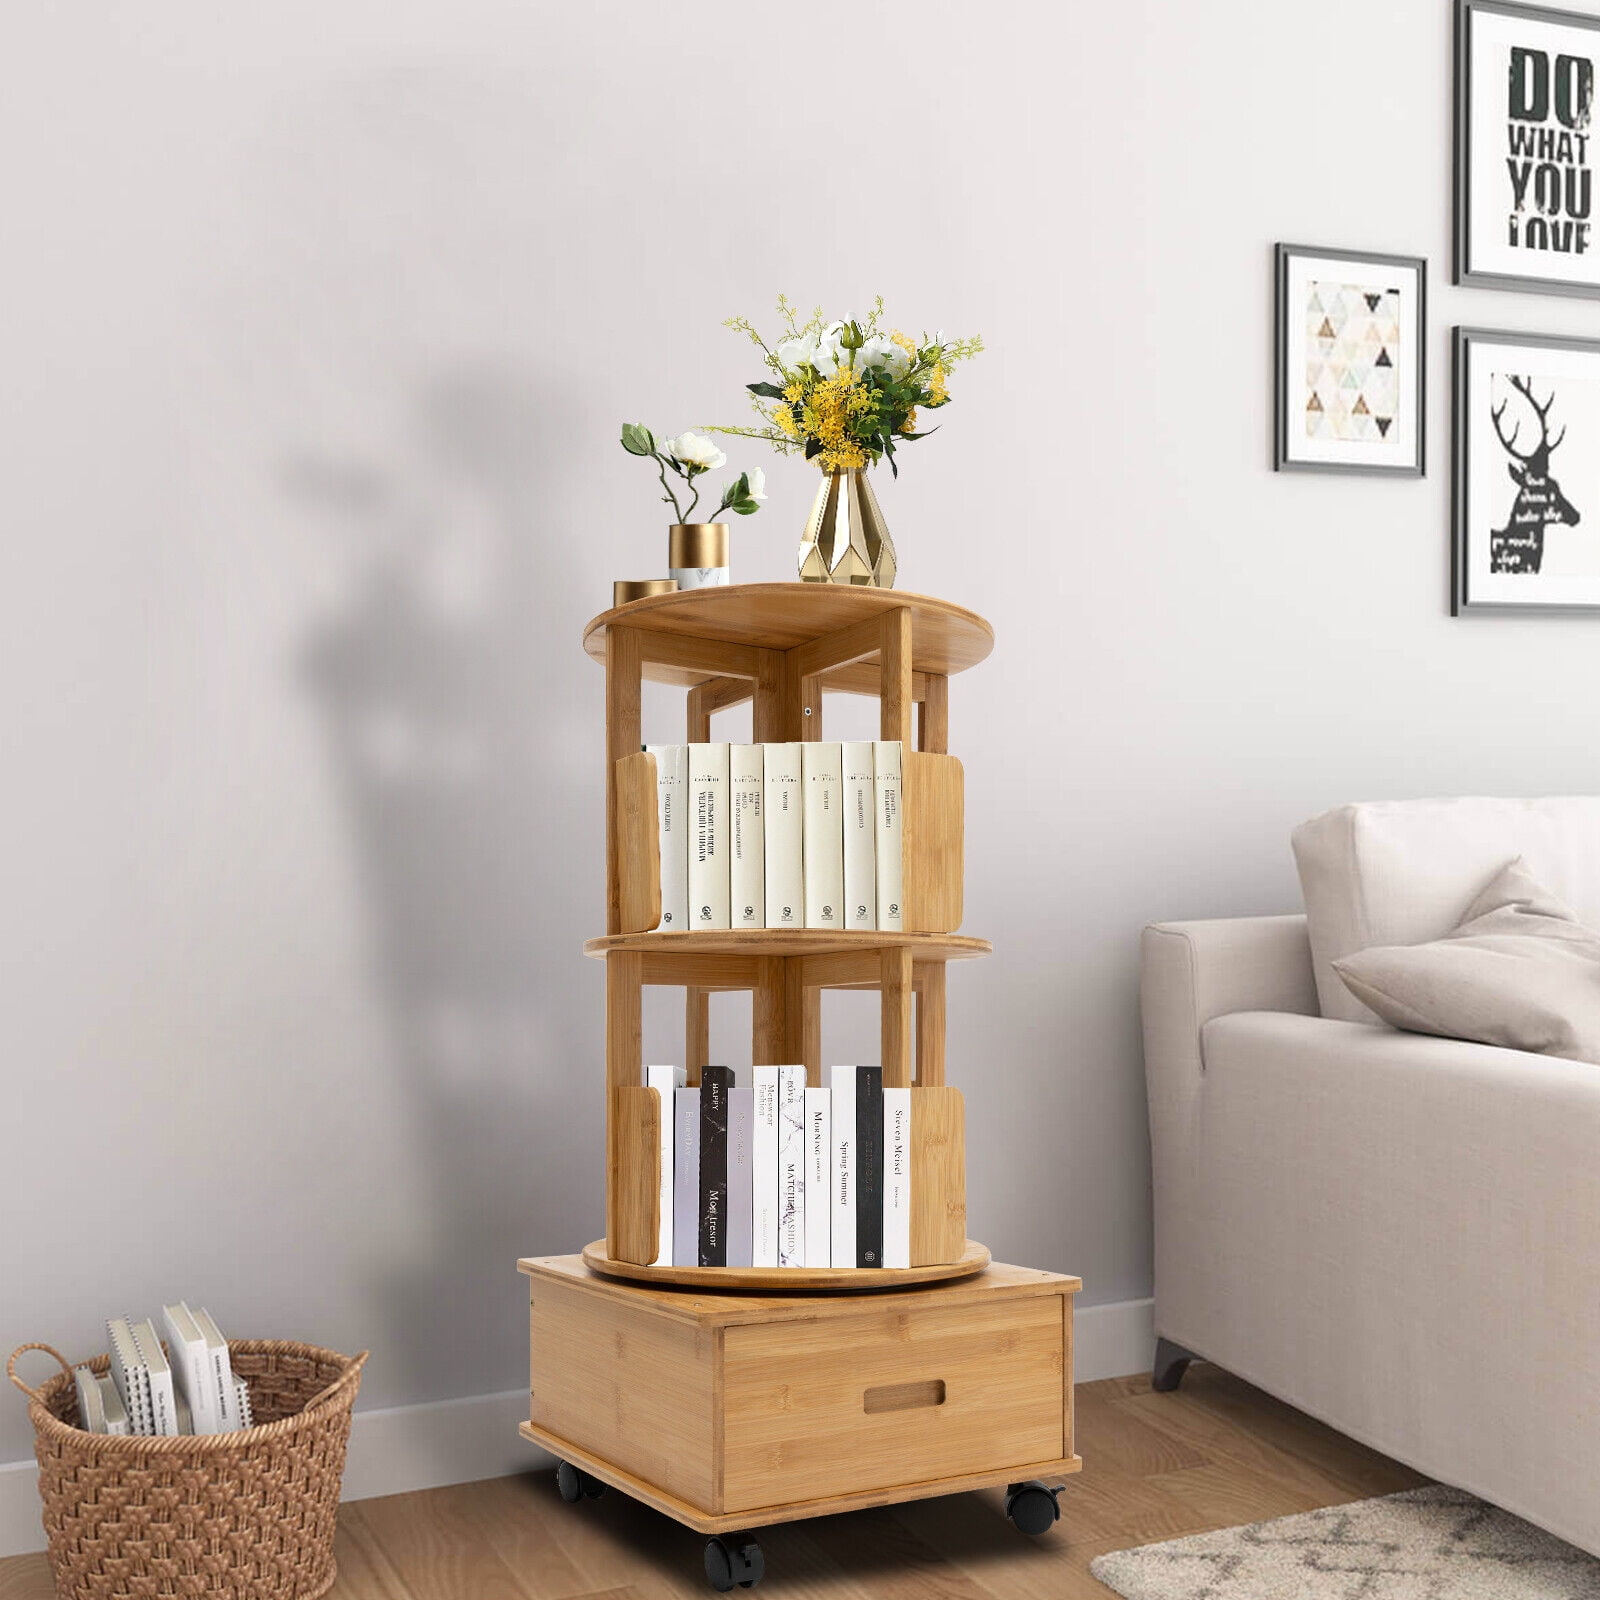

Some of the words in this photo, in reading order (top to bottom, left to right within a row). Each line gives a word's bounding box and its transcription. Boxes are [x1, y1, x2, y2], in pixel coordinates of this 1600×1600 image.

[1508, 46, 1593, 130] DO
[1507, 123, 1590, 165] WHAT
[1506, 157, 1592, 220] YOU
[759, 1084, 767, 1116] Fashion
[767, 1084, 775, 1127] Menswear
[894, 1109, 903, 1141] Steven
[839, 1141, 849, 1169] Spring
[840, 1171, 849, 1206] Summer
